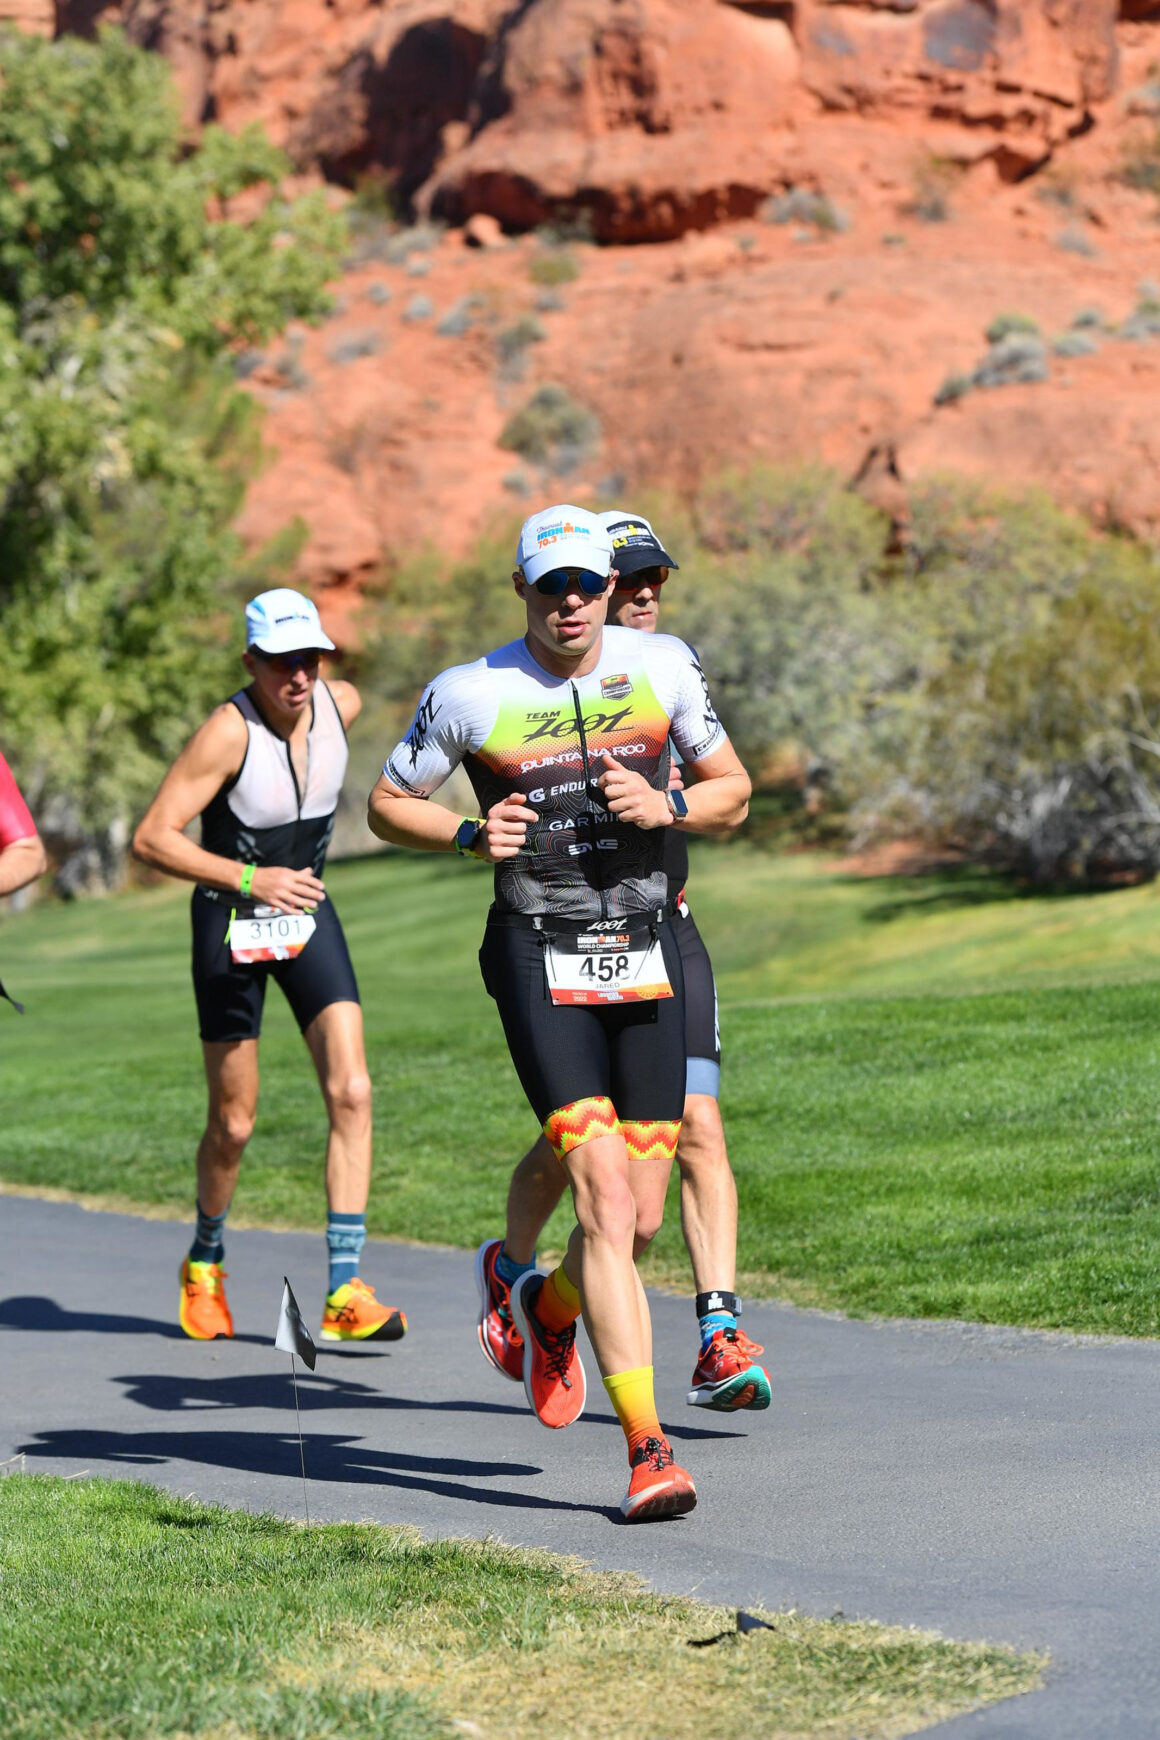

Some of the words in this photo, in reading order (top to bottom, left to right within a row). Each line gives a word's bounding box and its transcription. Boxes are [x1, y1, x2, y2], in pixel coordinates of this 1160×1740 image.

[538, 535, 558, 549] 70.3
[526, 710, 561, 719] TEAM
[612, 743, 646, 757] ROO
[250, 919, 300, 939] 3101
[579, 955, 630, 982] 458
